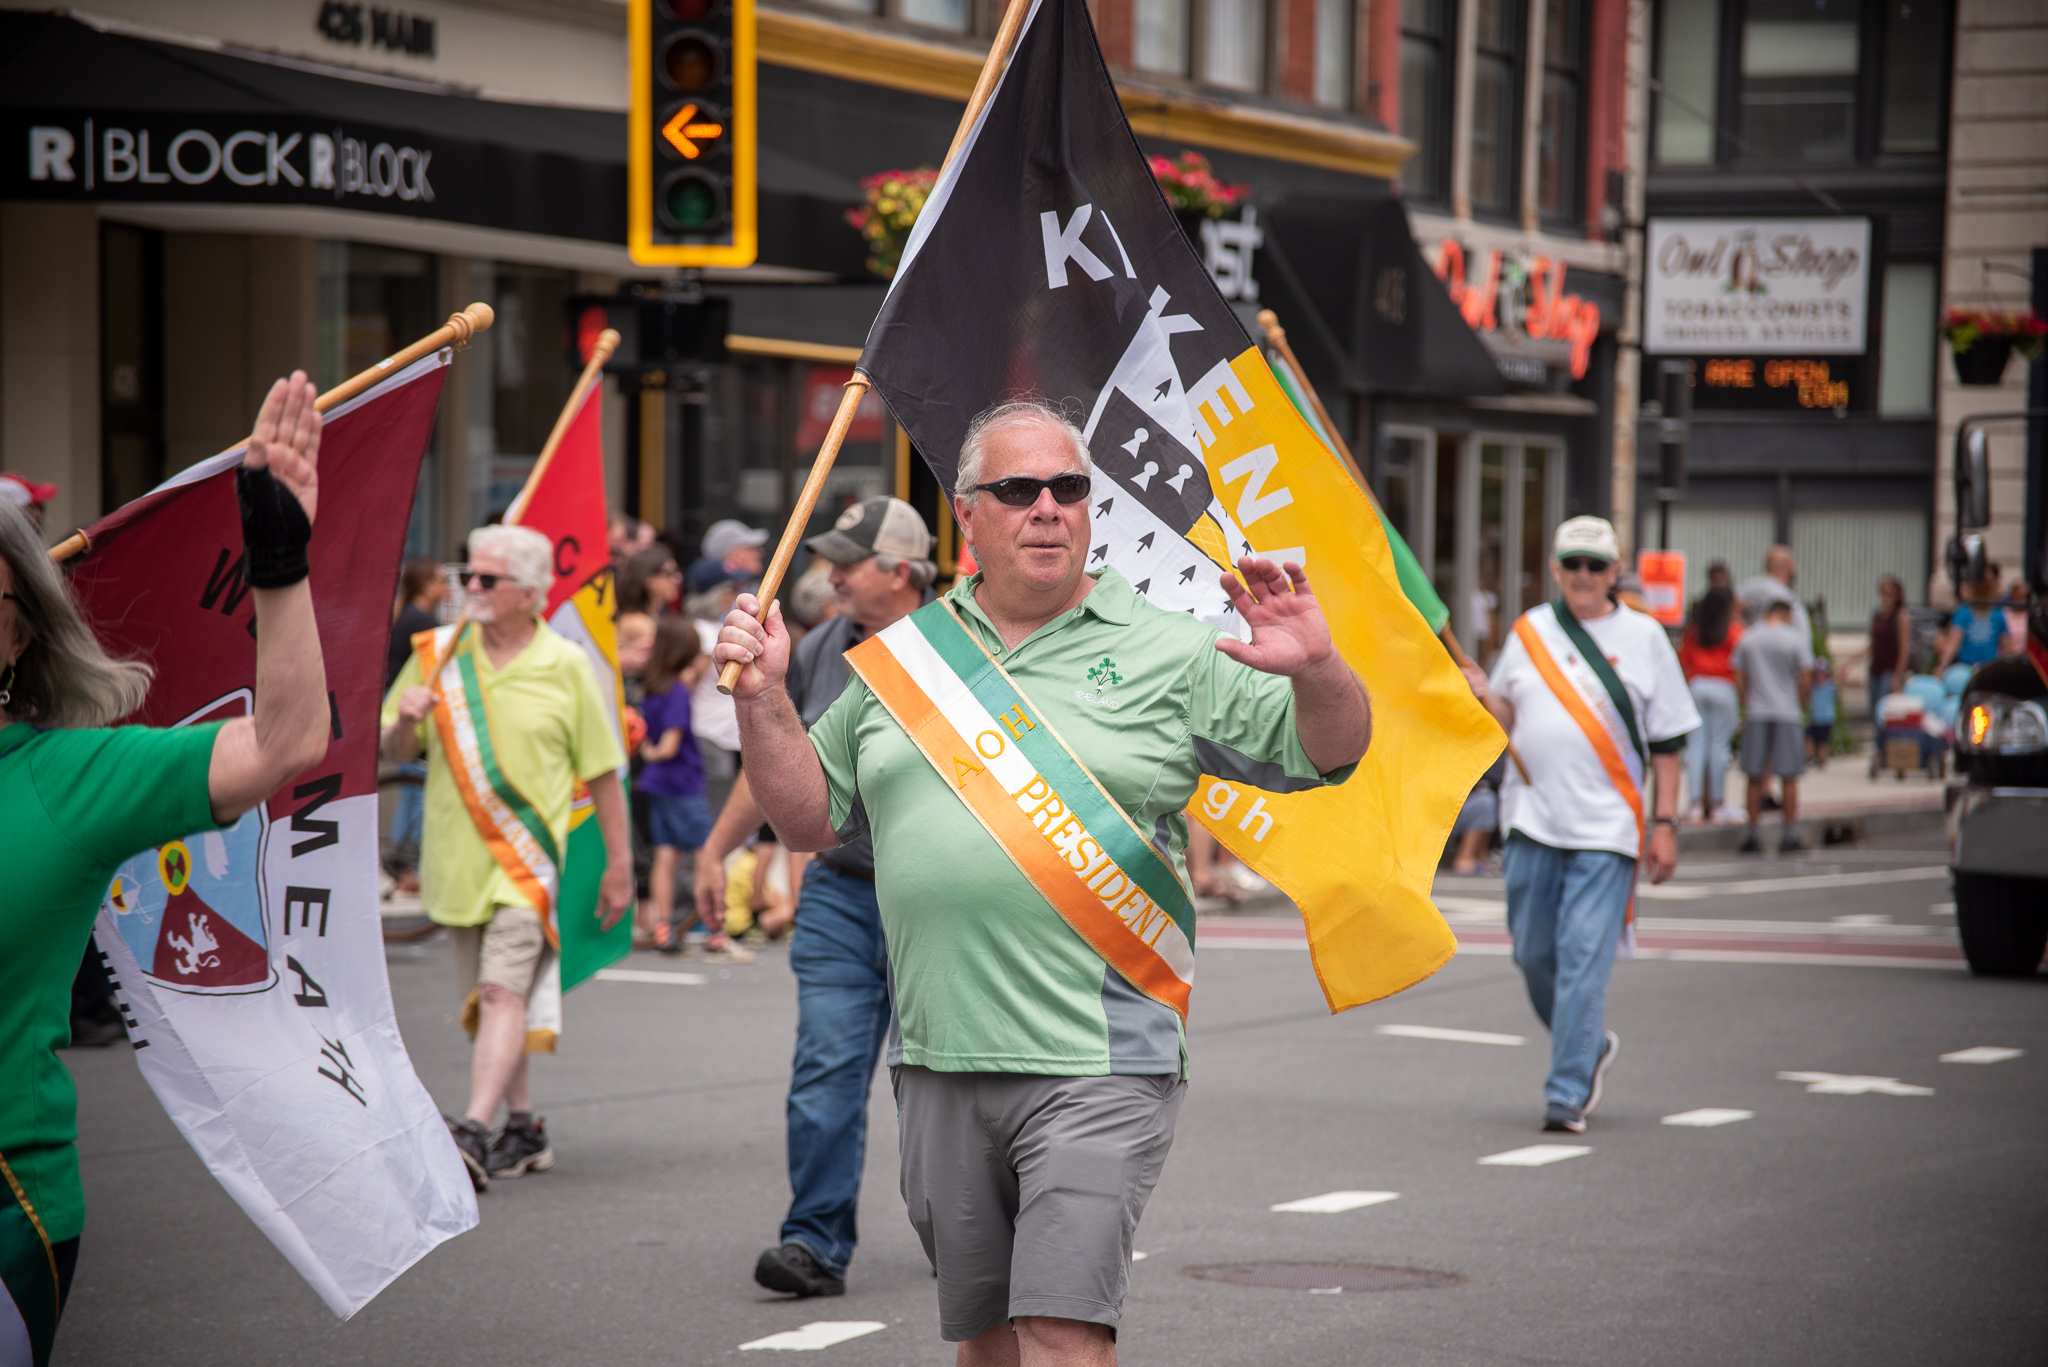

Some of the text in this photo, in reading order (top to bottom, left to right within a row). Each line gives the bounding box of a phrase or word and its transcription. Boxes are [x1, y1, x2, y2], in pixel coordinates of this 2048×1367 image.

[369, 7, 437, 59] MAIN
[1657, 233, 1860, 293] Owl Shop
[1525, 252, 1600, 381] Shop
[1705, 359, 1755, 387] ARE
[1074, 690, 1120, 709] IRELAND
[1011, 773, 1175, 949] PRESIDENT
